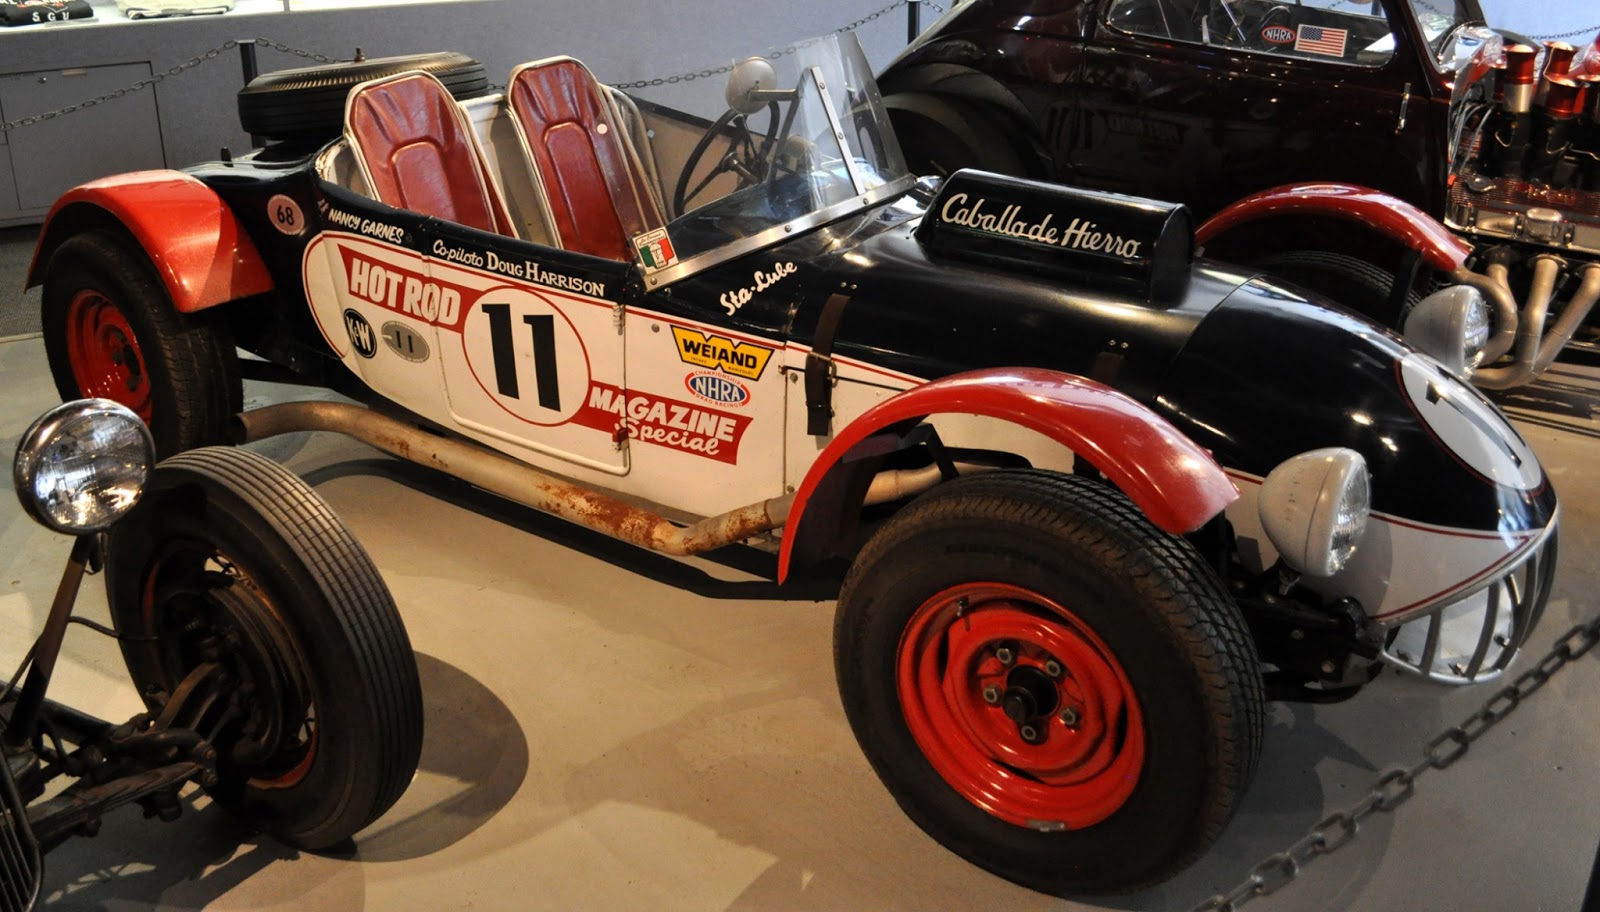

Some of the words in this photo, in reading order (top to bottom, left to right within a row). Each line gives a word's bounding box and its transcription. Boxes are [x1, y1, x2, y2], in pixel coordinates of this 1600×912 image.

[1266, 28, 1292, 40] NHRA
[277, 205, 294, 226] 68
[328, 207, 361, 230] NANCY
[361, 219, 404, 244] GARNES
[941, 193, 1028, 237] Caballo
[1028, 214, 1059, 243] de
[1060, 218, 1142, 258] Hierro
[433, 239, 484, 268] Co-piloto
[350, 257, 403, 308] HOT
[402, 275, 462, 327] ROD
[481, 303, 562, 413] 11
[682, 338, 758, 370] WEIAND
[694, 370, 742, 385] CHAMPIONSHIP
[695, 376, 741, 403] NHRA
[588, 385, 737, 443] MAGAZINE
[695, 392, 713, 405] DRAG
[614, 417, 721, 456] Special
